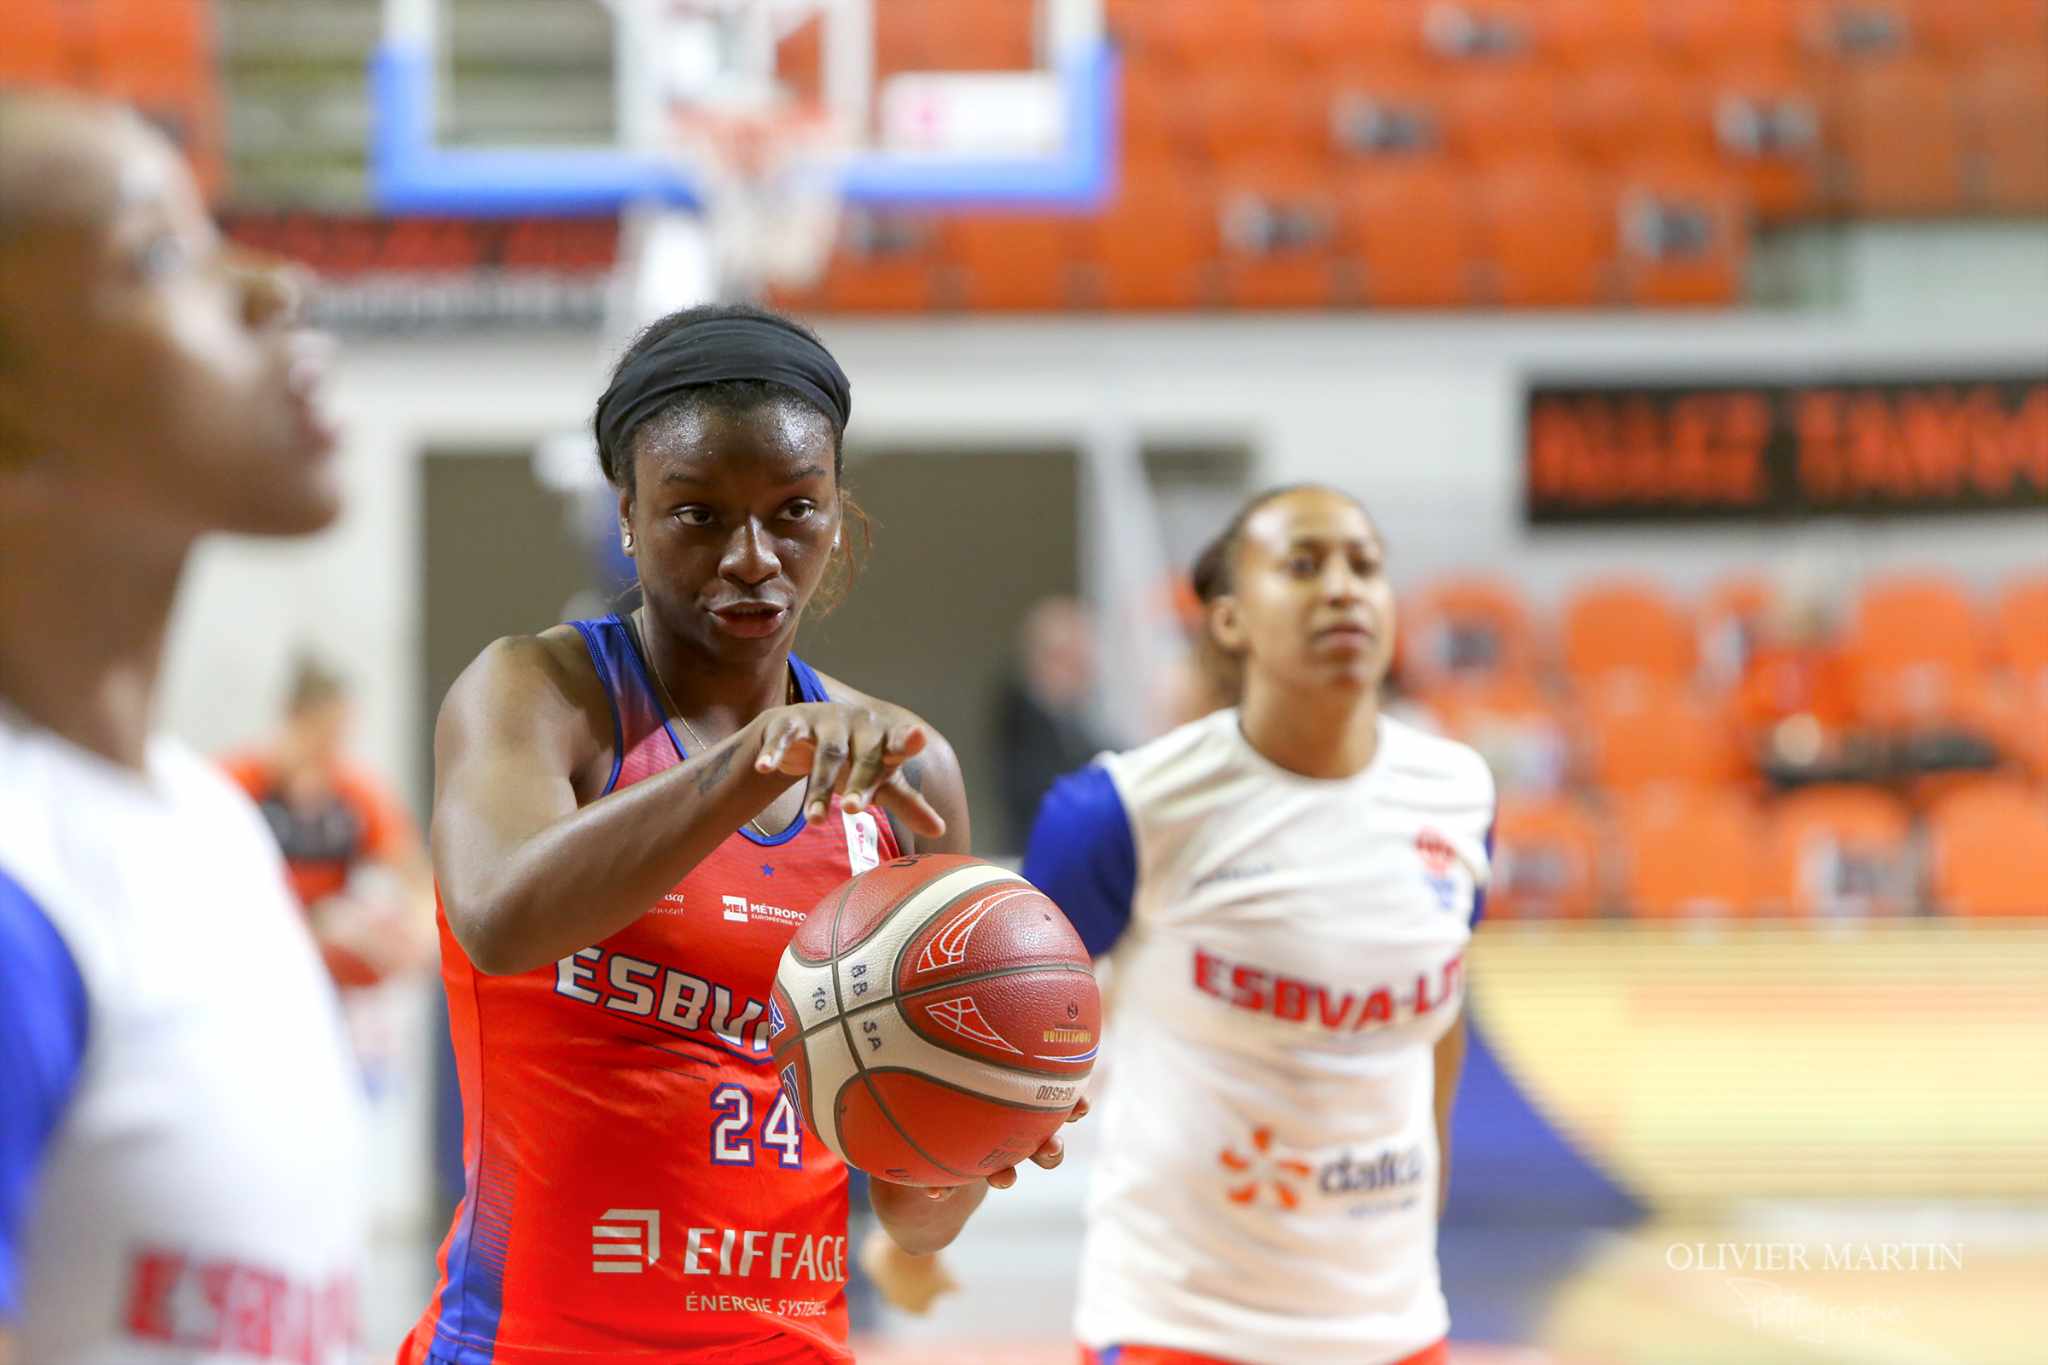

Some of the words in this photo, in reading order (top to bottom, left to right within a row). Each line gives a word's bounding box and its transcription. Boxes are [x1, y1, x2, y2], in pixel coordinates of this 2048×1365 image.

[750, 903, 808, 921] MÉTROPO
[709, 1082, 804, 1169] 24
[683, 1227, 846, 1283] EIFFAGE
[685, 1291, 774, 1315] ÉNERGIE
